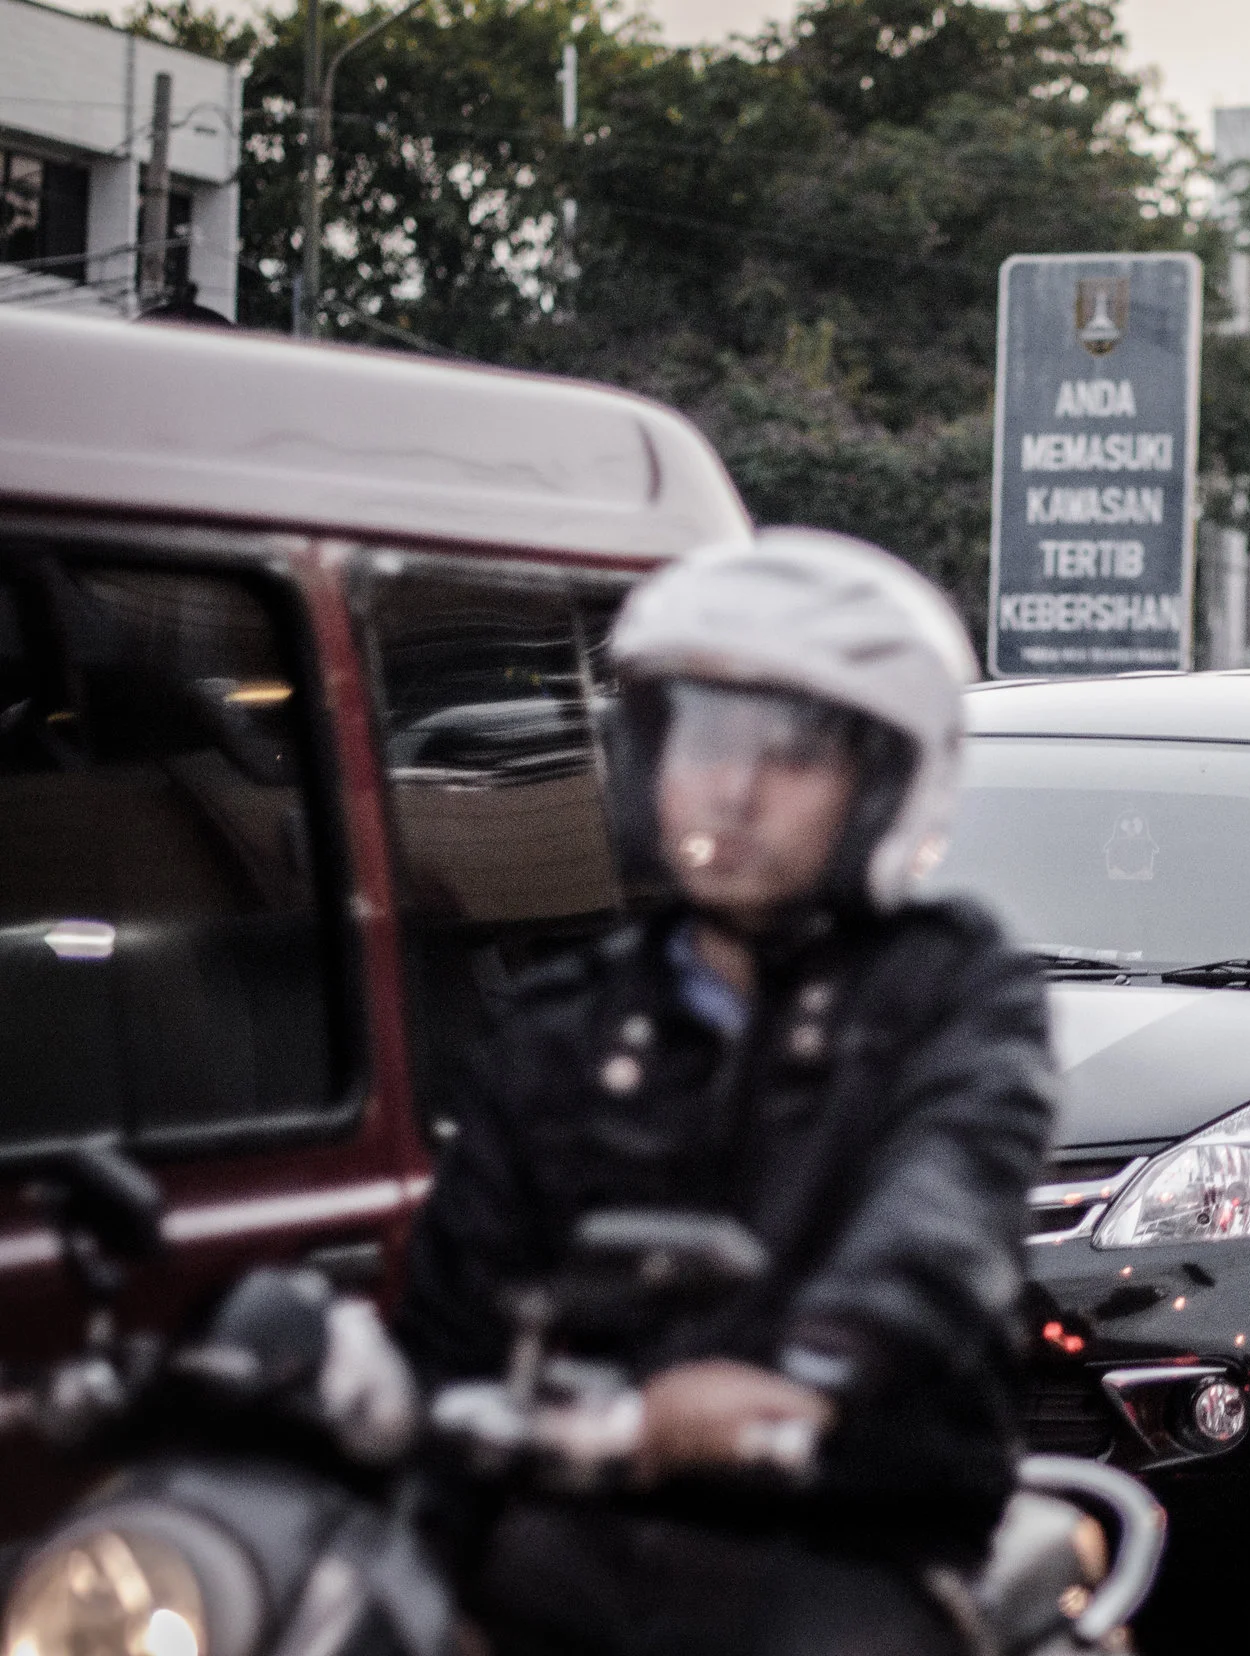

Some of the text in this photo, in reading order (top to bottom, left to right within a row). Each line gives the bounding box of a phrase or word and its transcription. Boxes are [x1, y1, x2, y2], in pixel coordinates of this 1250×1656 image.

[1055, 379, 1136, 417] ANDA
[1021, 433, 1173, 471] MEMASUKI
[1026, 486, 1164, 525] KAWASAN
[1039, 540, 1144, 578] TERTIB
